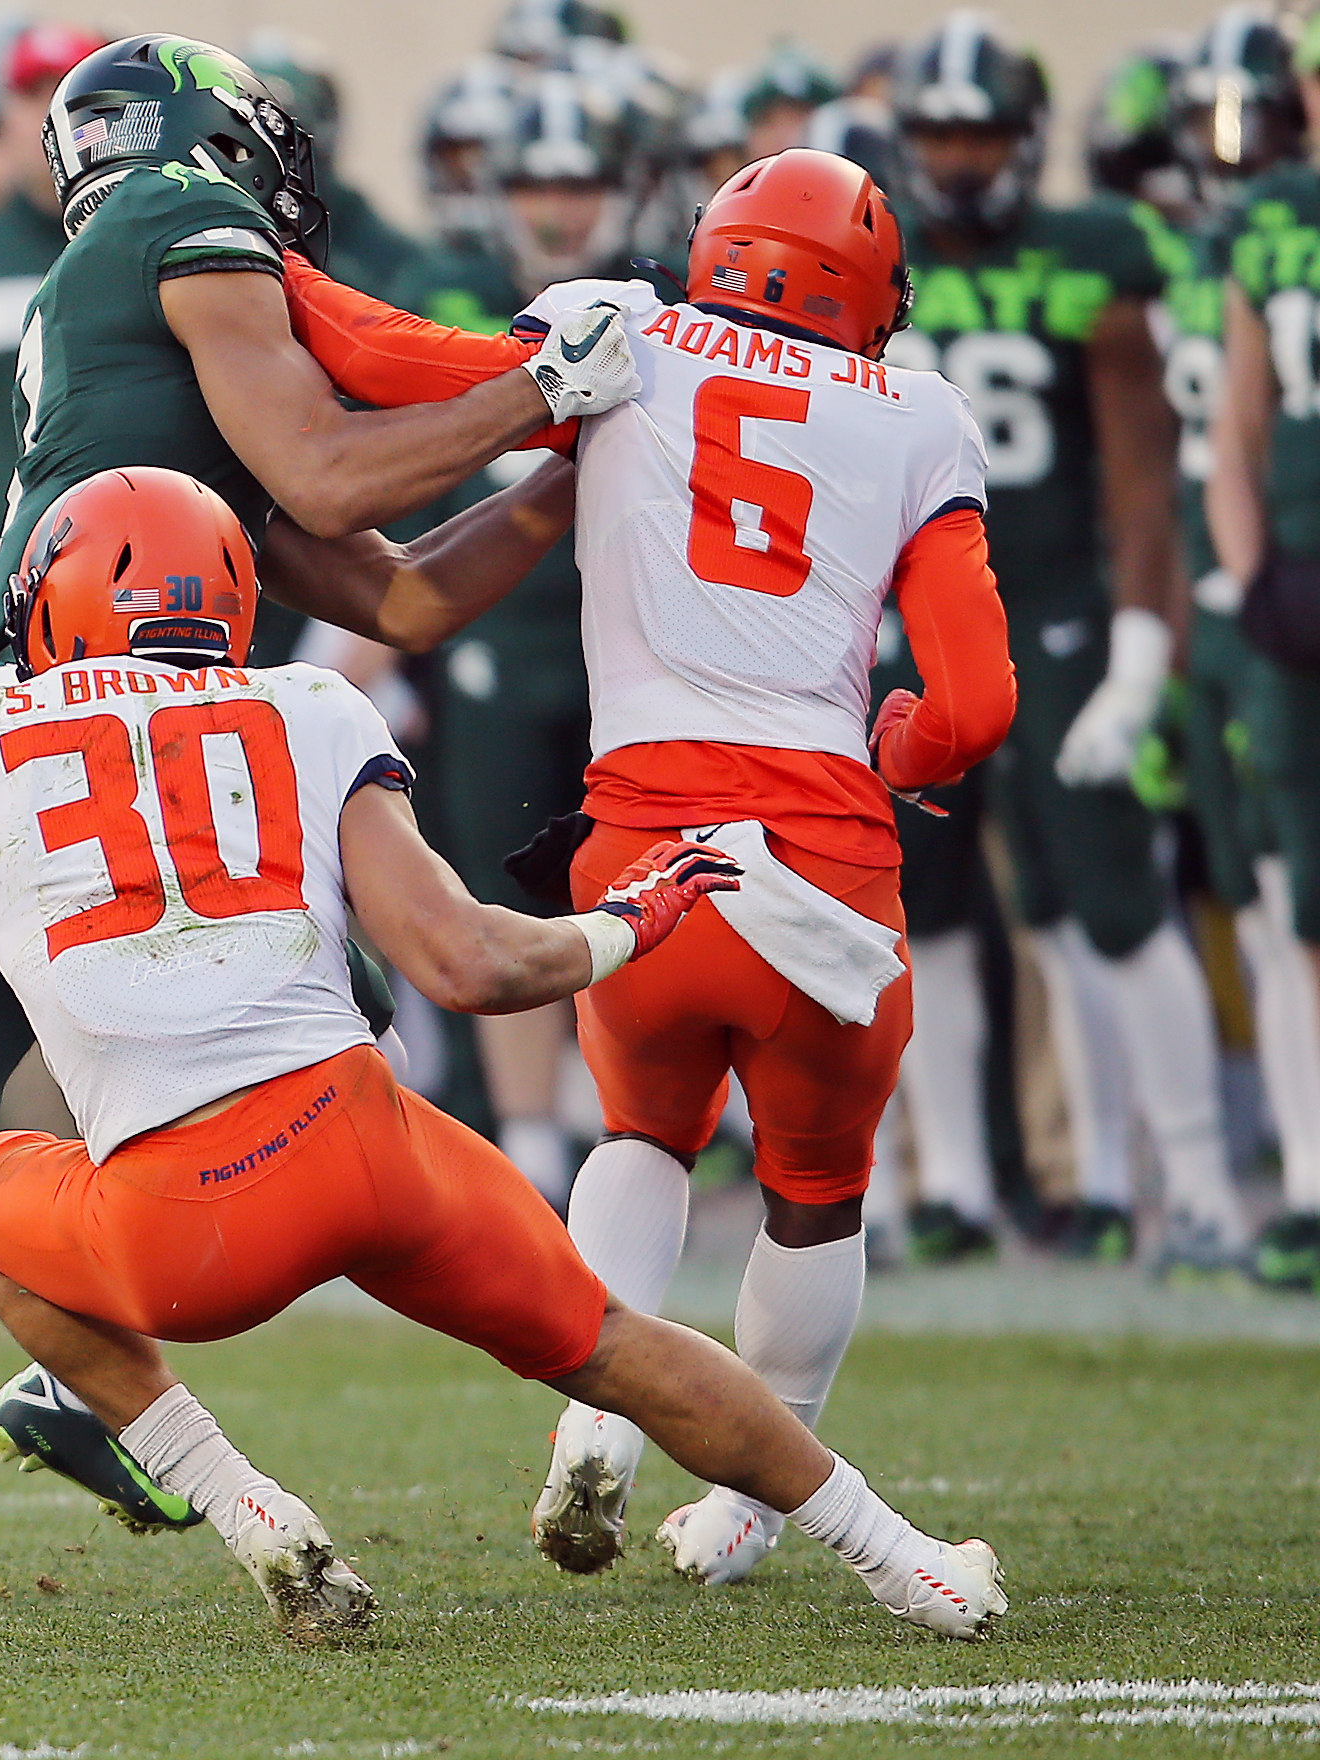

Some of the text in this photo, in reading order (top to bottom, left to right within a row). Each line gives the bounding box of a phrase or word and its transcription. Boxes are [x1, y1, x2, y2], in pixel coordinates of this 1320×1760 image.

[763, 268, 787, 303] 6
[641, 309, 901, 401] ADAMS JR.
[687, 375, 814, 598] 6
[165, 575, 202, 612] 30
[137, 626, 223, 642] FIGHTING ILLINI
[5, 667, 250, 715] S. BROWN
[199, 1085, 337, 1186] FIGHTING ILLINI
